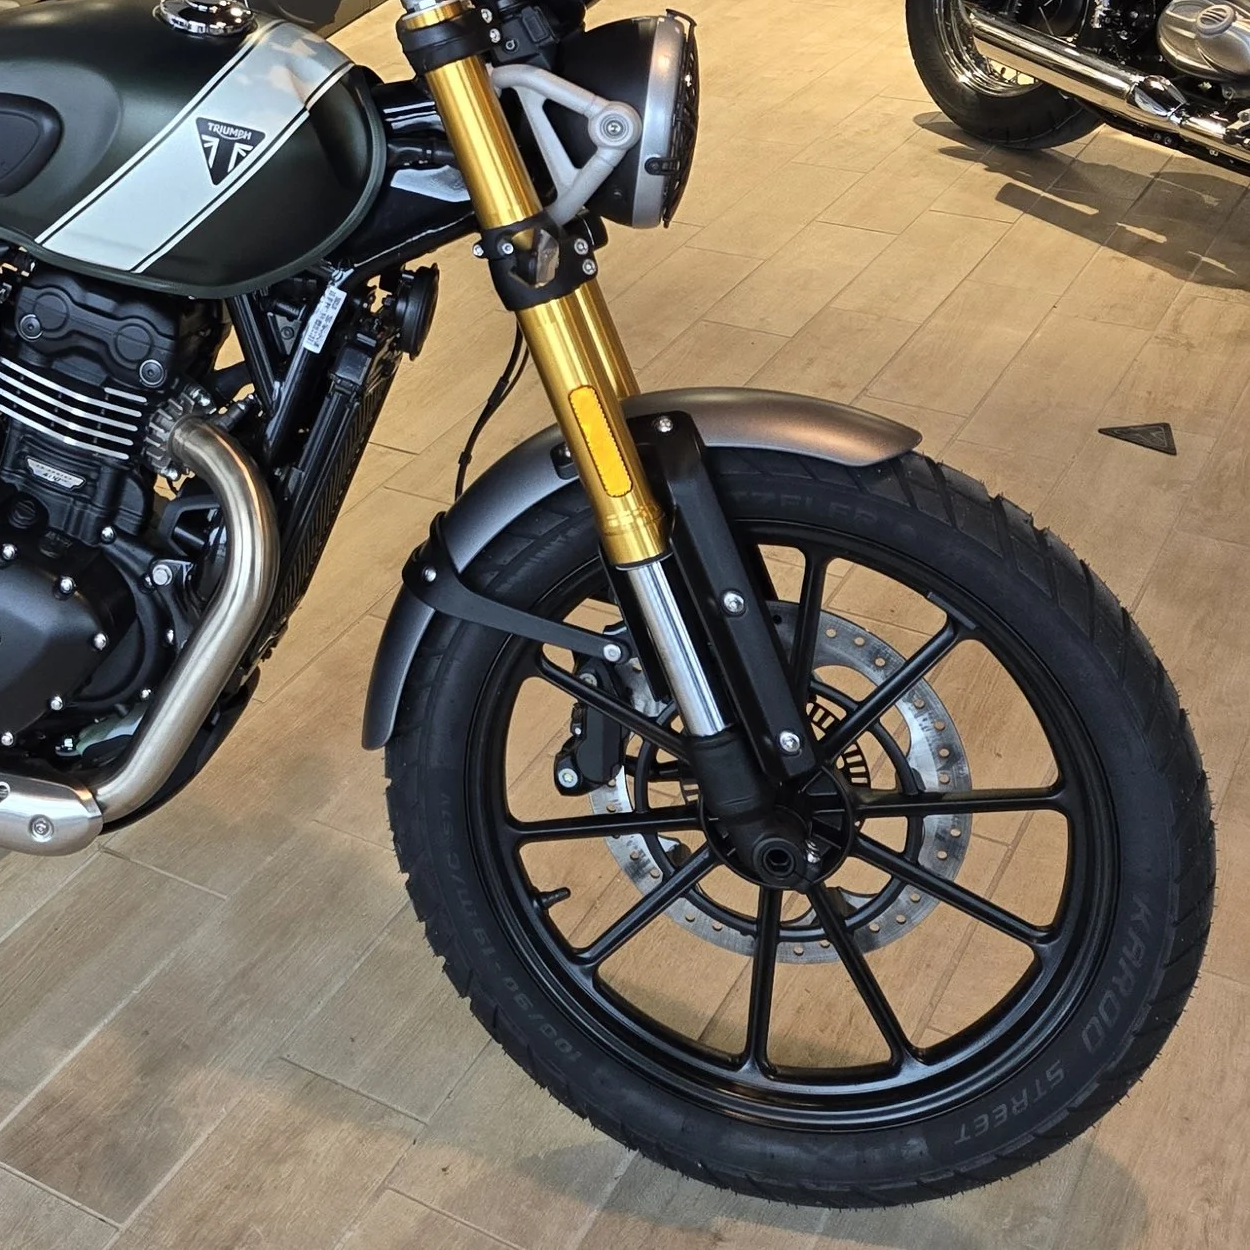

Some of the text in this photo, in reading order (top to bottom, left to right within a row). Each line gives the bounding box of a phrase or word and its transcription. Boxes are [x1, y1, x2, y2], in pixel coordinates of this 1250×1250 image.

[207, 122, 253, 141] TRIUMPH
[954, 896, 1152, 1145] KAROO STREET
